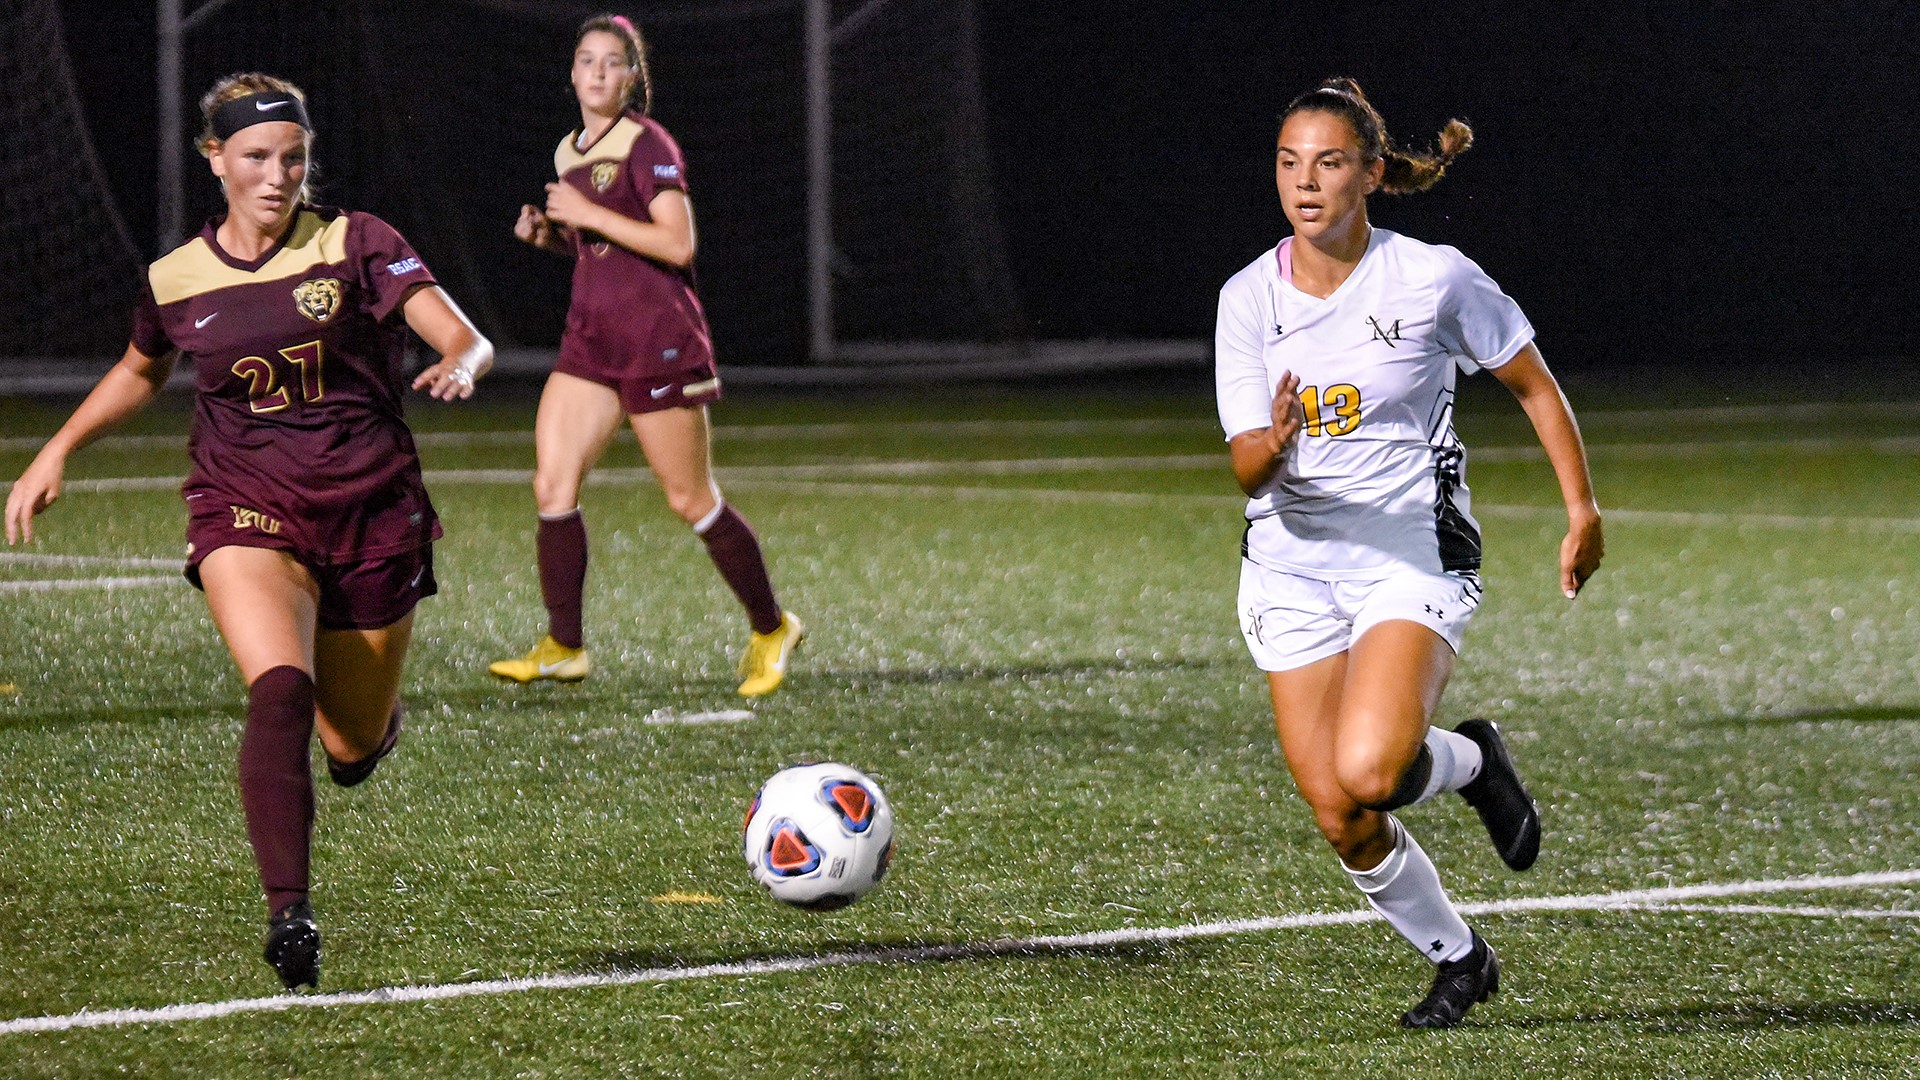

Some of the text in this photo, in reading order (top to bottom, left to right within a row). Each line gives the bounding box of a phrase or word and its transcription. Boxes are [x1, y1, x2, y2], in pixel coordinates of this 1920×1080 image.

[387, 257, 421, 276] PSAC
[231, 340, 324, 413] 27
[1298, 383, 1362, 437] 13
